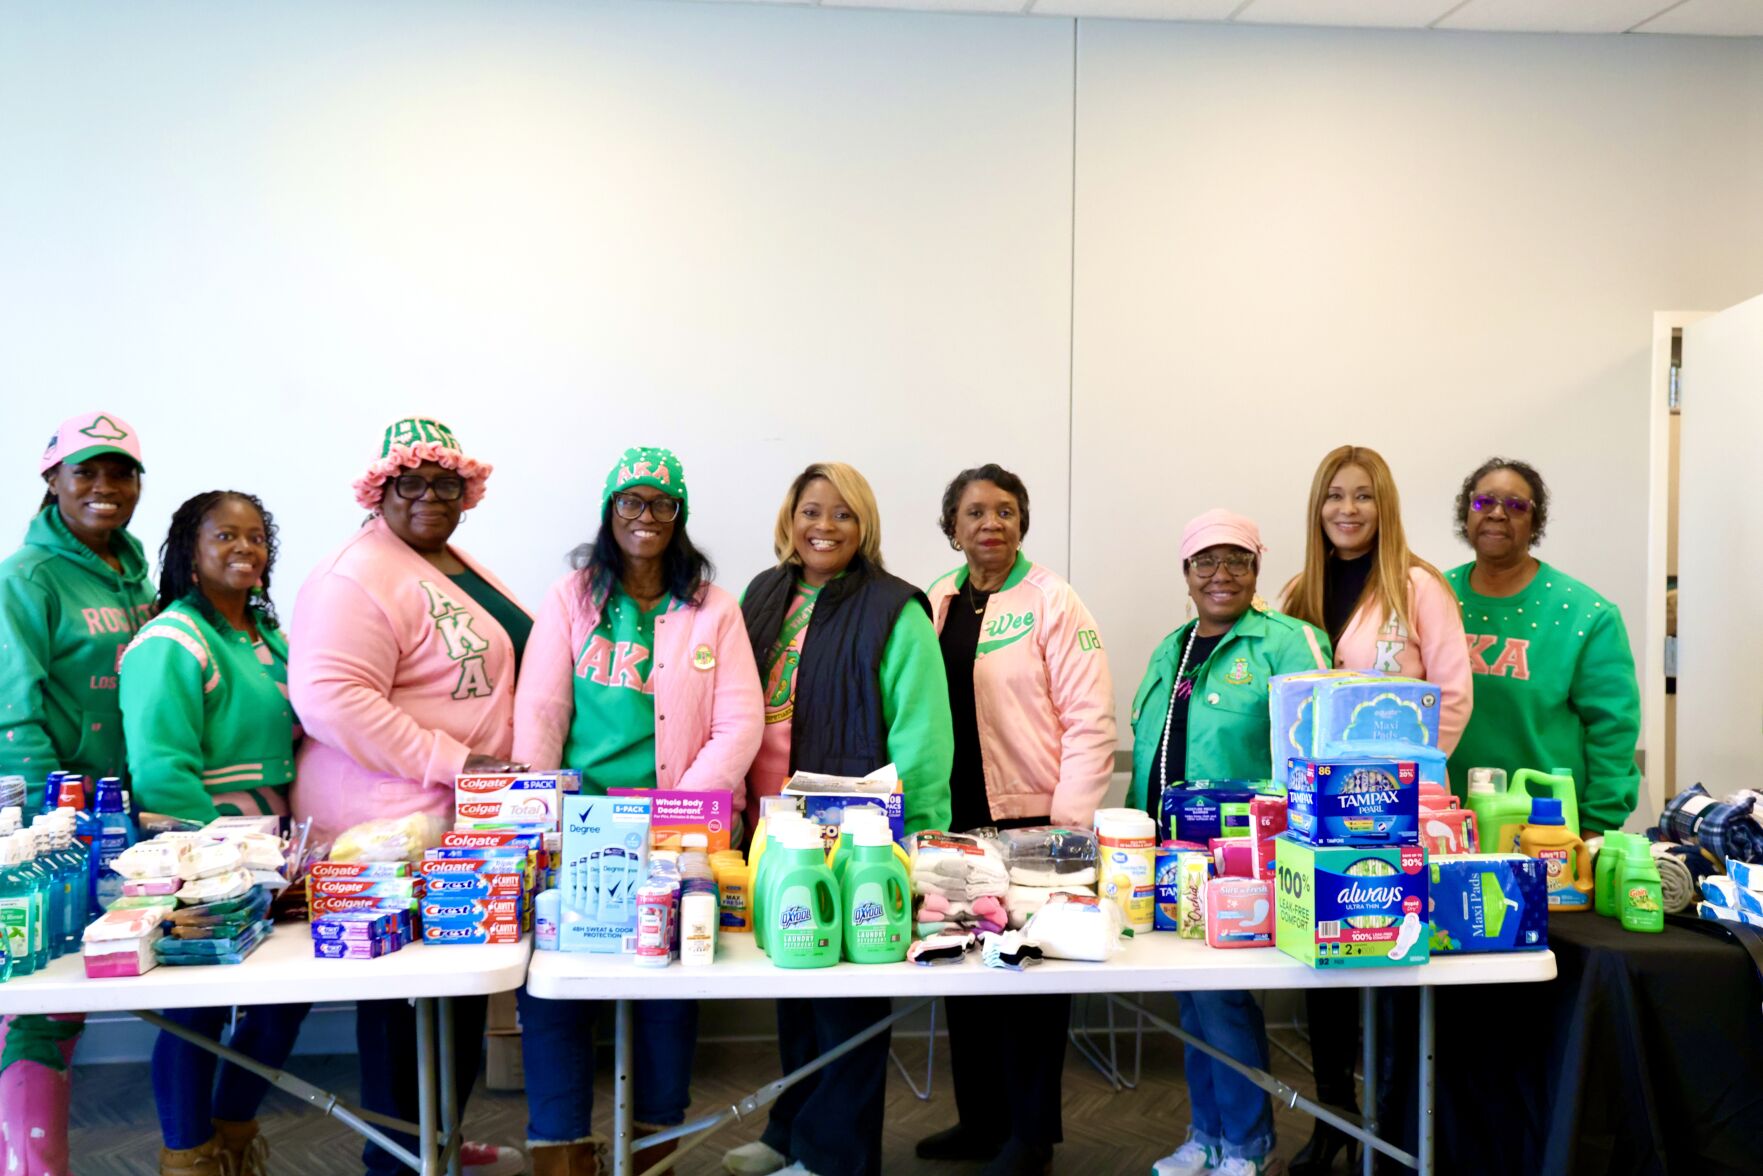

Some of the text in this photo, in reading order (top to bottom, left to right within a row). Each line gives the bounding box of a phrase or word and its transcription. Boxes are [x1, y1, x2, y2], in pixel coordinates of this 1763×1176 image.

[616, 460, 671, 487] AKA
[985, 611, 1035, 637] Wee
[1373, 720, 1399, 731] Maxi
[1318, 766, 1332, 776] 86
[460, 778, 507, 790] Colgate
[530, 781, 553, 789] PACK
[655, 798, 704, 808] Whole Body
[1289, 791, 1314, 805] TAMPAX
[1337, 790, 1400, 809] TAMPAX
[510, 805, 541, 815] Total
[615, 805, 645, 813] 5-PACK
[657, 806, 701, 814] Deodorant
[711, 800, 720, 812] 3
[569, 824, 601, 836] Degree
[444, 834, 502, 847] Colgate
[1402, 858, 1423, 867] 30%
[312, 865, 360, 876] Colgate
[321, 882, 363, 893] Colgate
[430, 880, 473, 890] Crest
[1278, 866, 1311, 899] 100%
[1337, 881, 1404, 909] always
[1469, 872, 1485, 937] Maxi Pads
[425, 905, 469, 916] Crest
[427, 927, 471, 938] Crest
[1351, 932, 1373, 942] 100%
